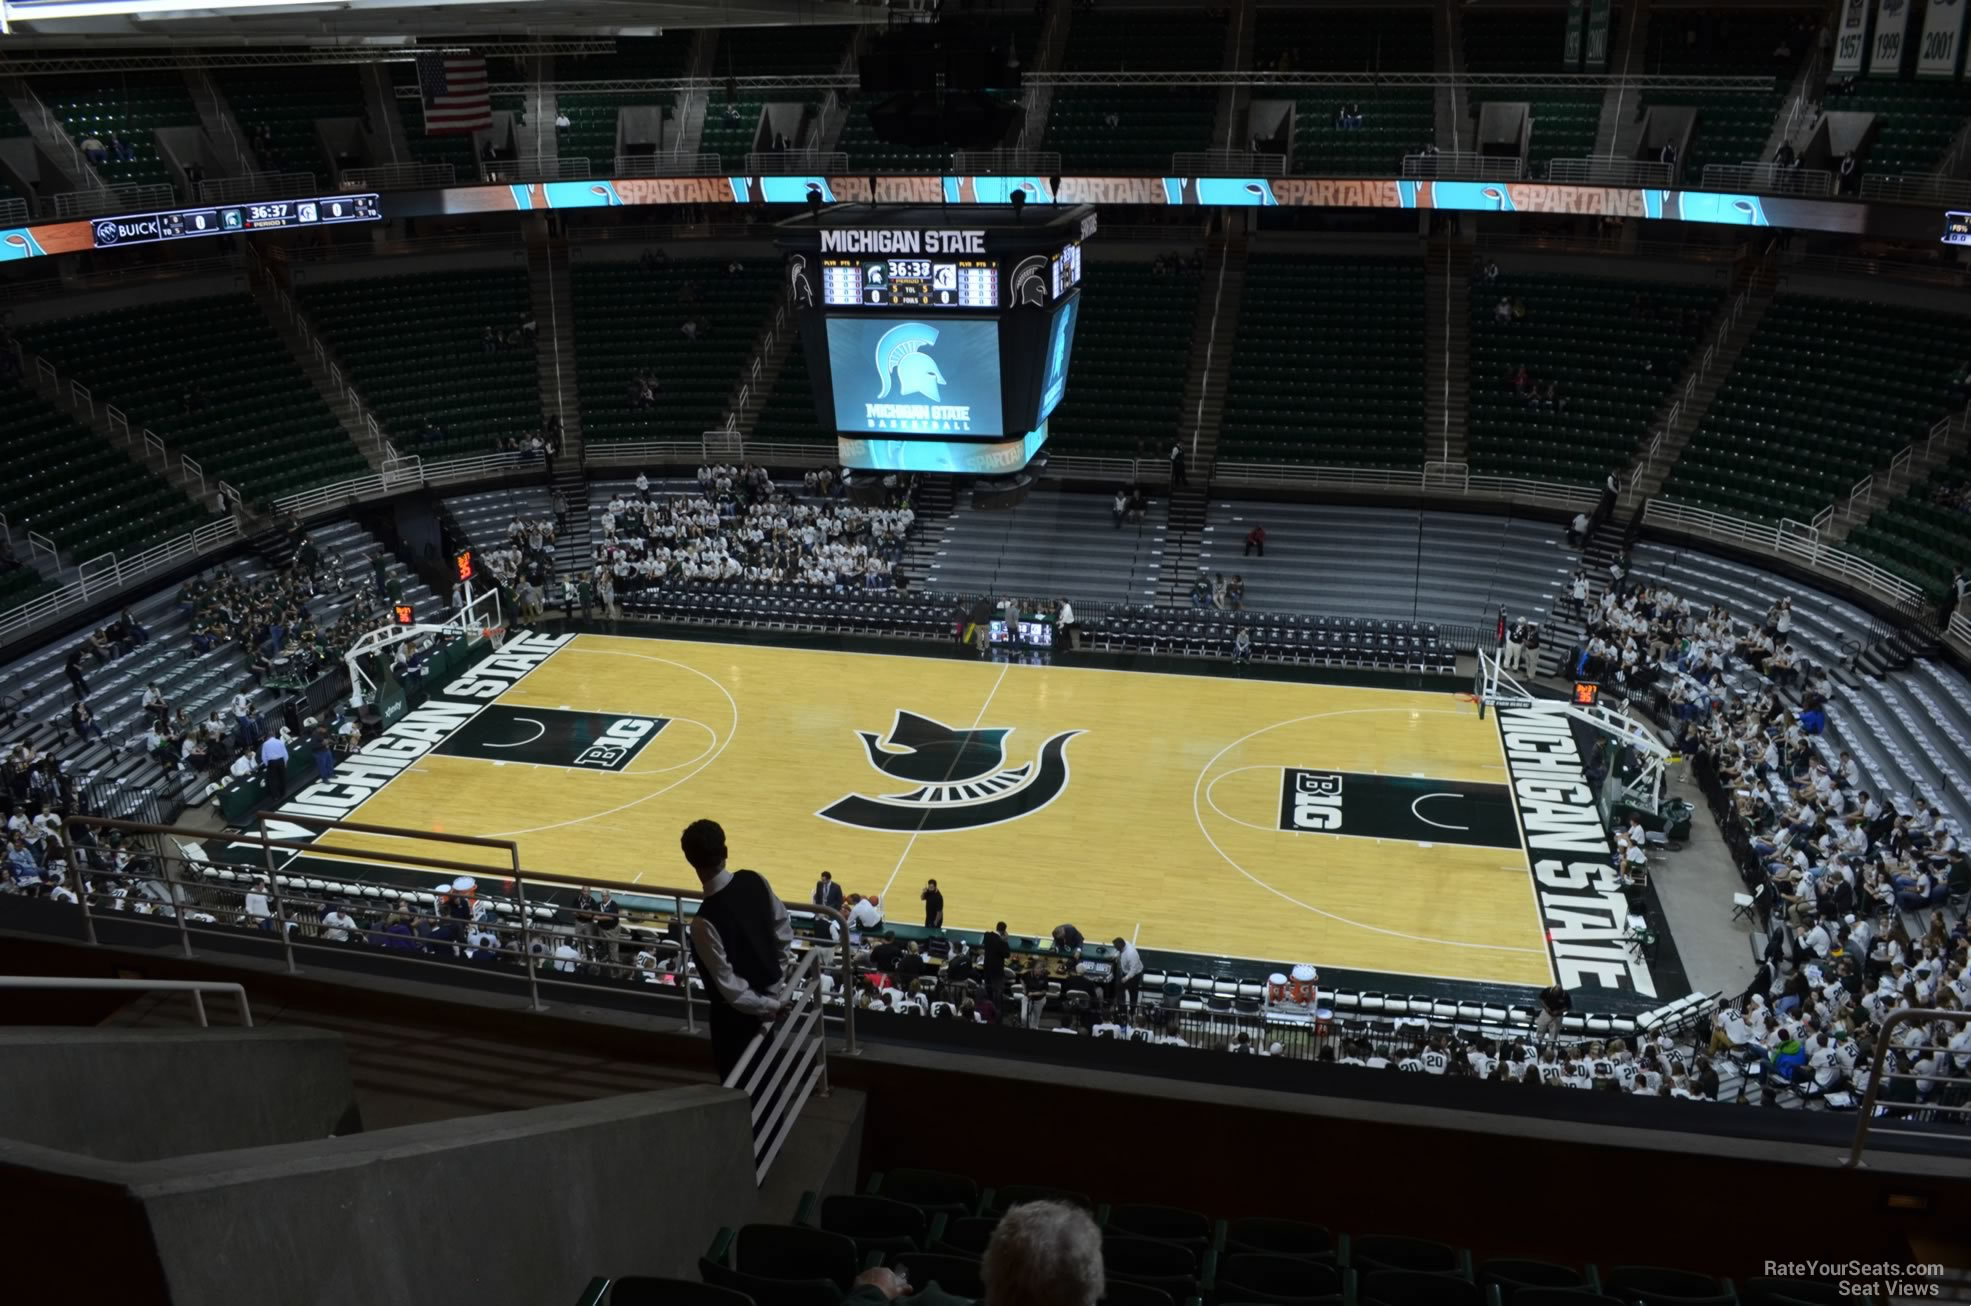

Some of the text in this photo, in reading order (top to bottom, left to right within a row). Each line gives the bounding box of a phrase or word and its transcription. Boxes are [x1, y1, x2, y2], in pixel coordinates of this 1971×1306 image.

[1839, 34, 1862, 59] 1957
[1876, 31, 1900, 60] 1999
[1923, 31, 1954, 60] 2001
[617, 179, 733, 204] SPARTANS
[832, 177, 943, 202] SPARTANS
[1273, 179, 1399, 207] SPARTANS
[1512, 184, 1643, 217] SPARTANS
[250, 204, 288, 219] 36:37
[332, 203, 342, 217] 0
[118, 221, 158, 238] BUICK
[195, 215, 206, 230] 0
[253, 220, 281, 228] PERIOD
[819, 230, 986, 254] MICHIGAN STATE
[871, 289, 880, 303] 0
[892, 284, 898, 293] 5
[922, 284, 928, 293] 5
[941, 290, 950, 304] 0
[865, 403, 971, 421] MICHIGAN STATE
[867, 418, 970, 431] BASKETBALL
[227, 630, 578, 857] MICHIGAN STATE
[1496, 706, 1658, 999] MICHIGAN STATE
[1426, 1055, 1443, 1068] 20
[1543, 1067, 1560, 1080] 20
